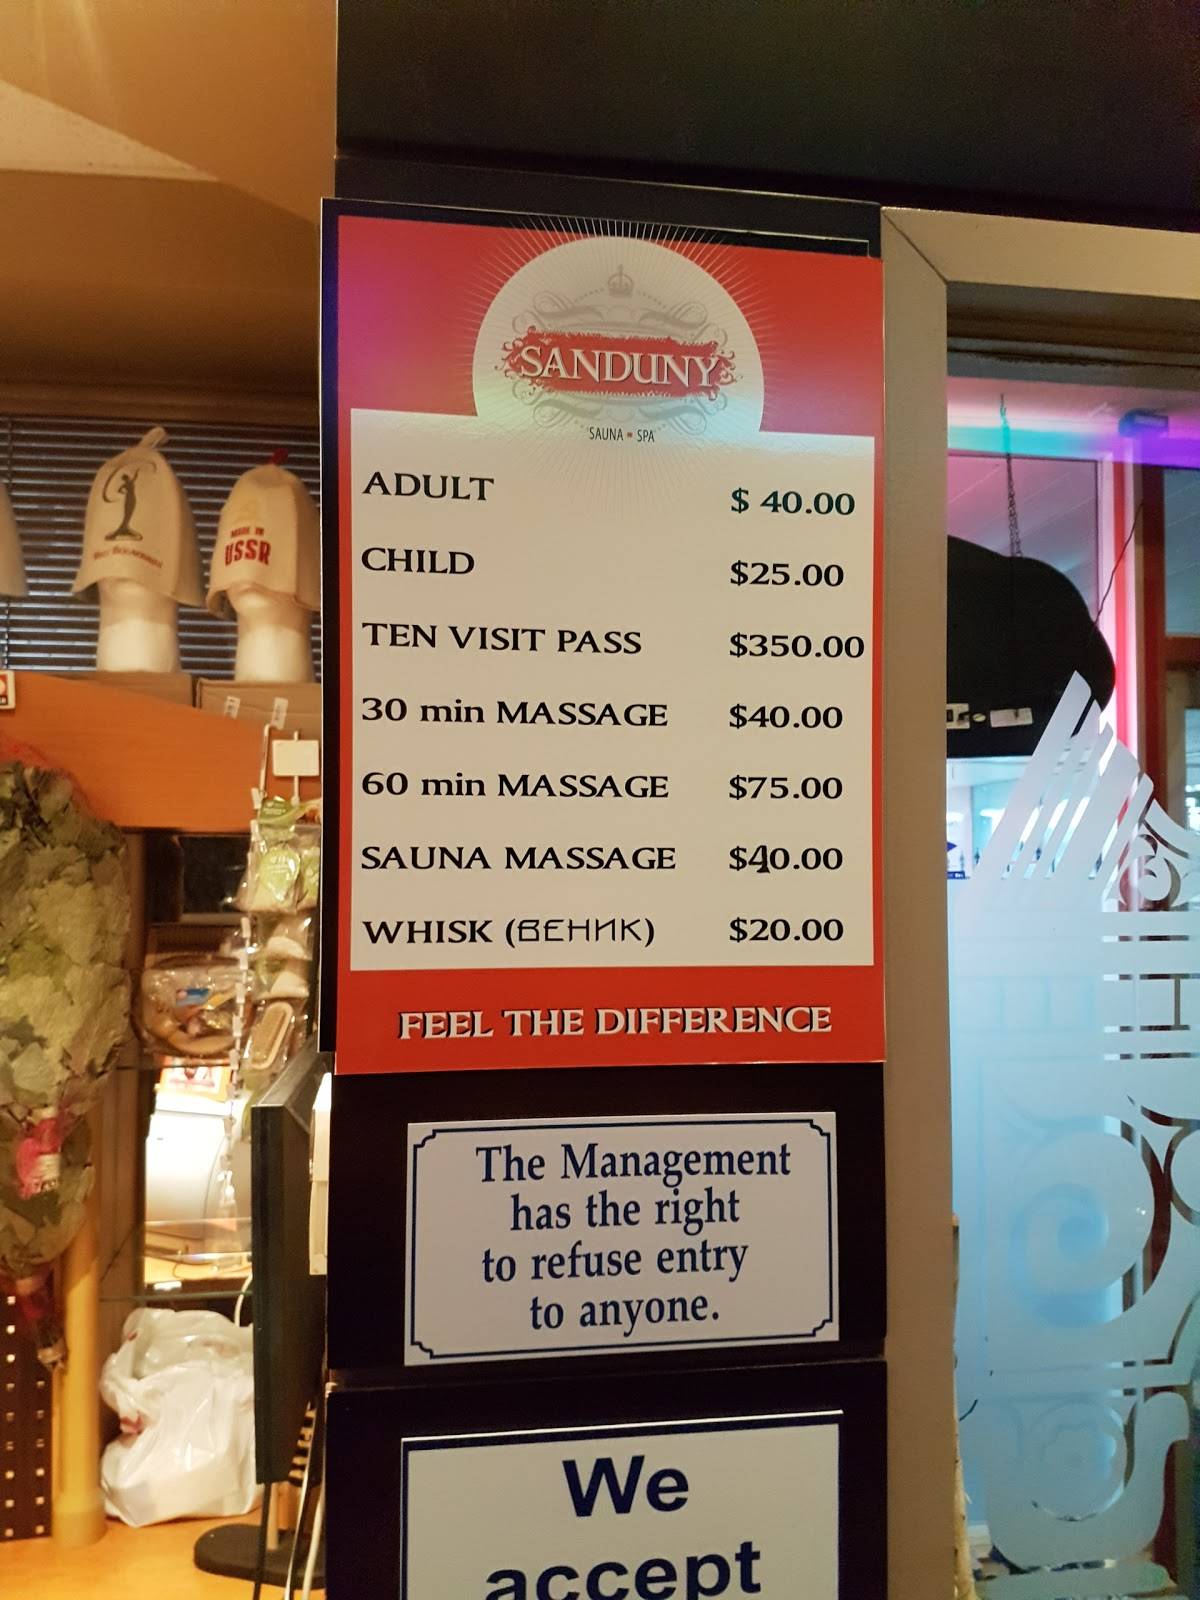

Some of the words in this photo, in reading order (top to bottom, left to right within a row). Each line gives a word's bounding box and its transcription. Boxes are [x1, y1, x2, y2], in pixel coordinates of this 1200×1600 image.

[520, 345, 719, 389] SANDUNY
[589, 426, 624, 441] SAUNA
[637, 429, 655, 443] SPA
[362, 471, 495, 501] ADULT
[759, 490, 855, 516] 40.00
[225, 539, 272, 566] USSR
[361, 547, 475, 575] CHILD
[730, 559, 844, 587] $25.00
[361, 622, 437, 649] TEN
[448, 625, 546, 652] VISIT
[557, 629, 642, 655] PASS
[729, 632, 865, 659] $350.00
[362, 697, 408, 722] 30
[420, 698, 485, 723] min
[497, 700, 668, 727] MASSAGE
[729, 703, 843, 730] $40.00
[362, 771, 409, 796] 60
[421, 772, 486, 796] min
[498, 773, 669, 798] MASSAGE
[729, 774, 843, 801] $75.00
[361, 846, 492, 870] SAUNA
[505, 846, 676, 870] MASSAGE
[729, 844, 843, 874] $40.00
[362, 920, 493, 944] WHISK
[729, 916, 844, 943] $20.00
[398, 1008, 494, 1041] FEEL
[502, 1007, 585, 1037] THE
[594, 1004, 833, 1037] DIFFERENCE
[475, 1143, 546, 1183] The
[560, 1142, 791, 1187] Management
[510, 1193, 571, 1231] has
[585, 1189, 641, 1228] the
[654, 1186, 740, 1236] right
[482, 1248, 516, 1283] to
[531, 1239, 642, 1280] refuse
[656, 1239, 749, 1282] entry
[529, 1296, 564, 1330] to
[579, 1295, 720, 1338] anyone.
[562, 1454, 689, 1518] We
[485, 1541, 762, 1600] accept
